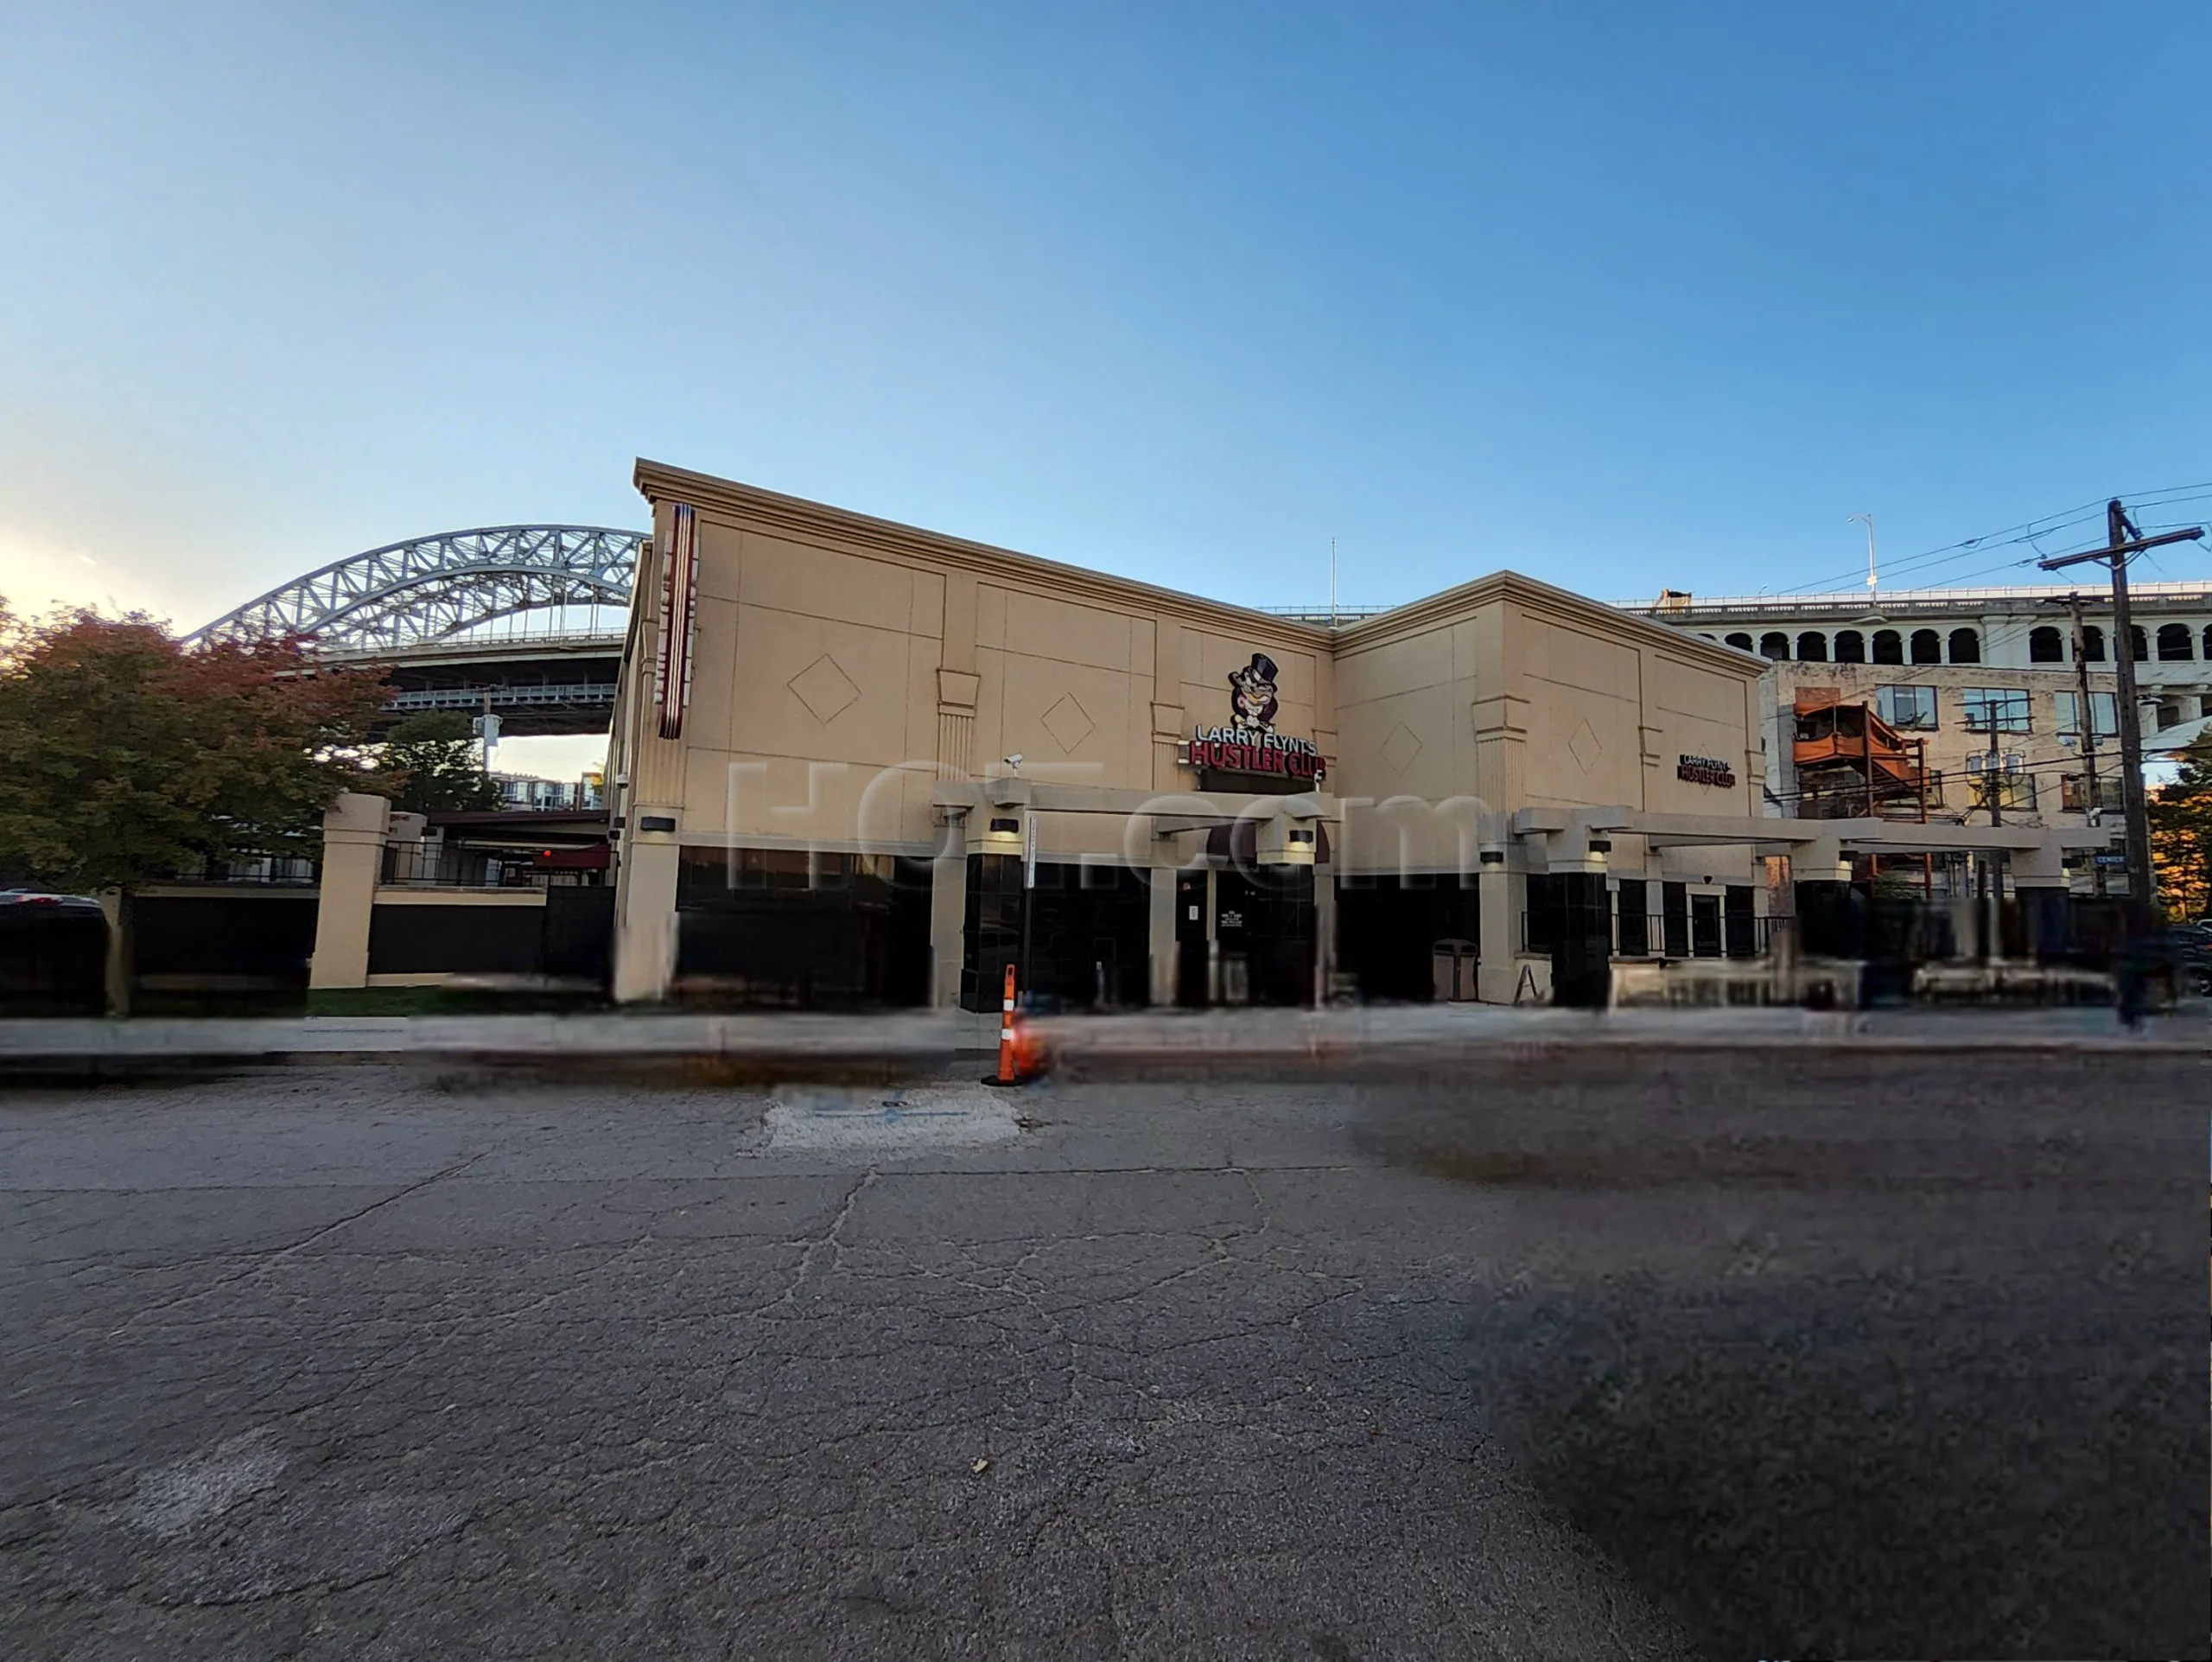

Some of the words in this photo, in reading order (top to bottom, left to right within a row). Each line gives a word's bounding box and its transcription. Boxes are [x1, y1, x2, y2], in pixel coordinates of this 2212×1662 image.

[1196, 723, 1259, 746] LARRY
[1189, 741, 1285, 773] HUSTLER
[1289, 752, 1327, 780] CLUB
